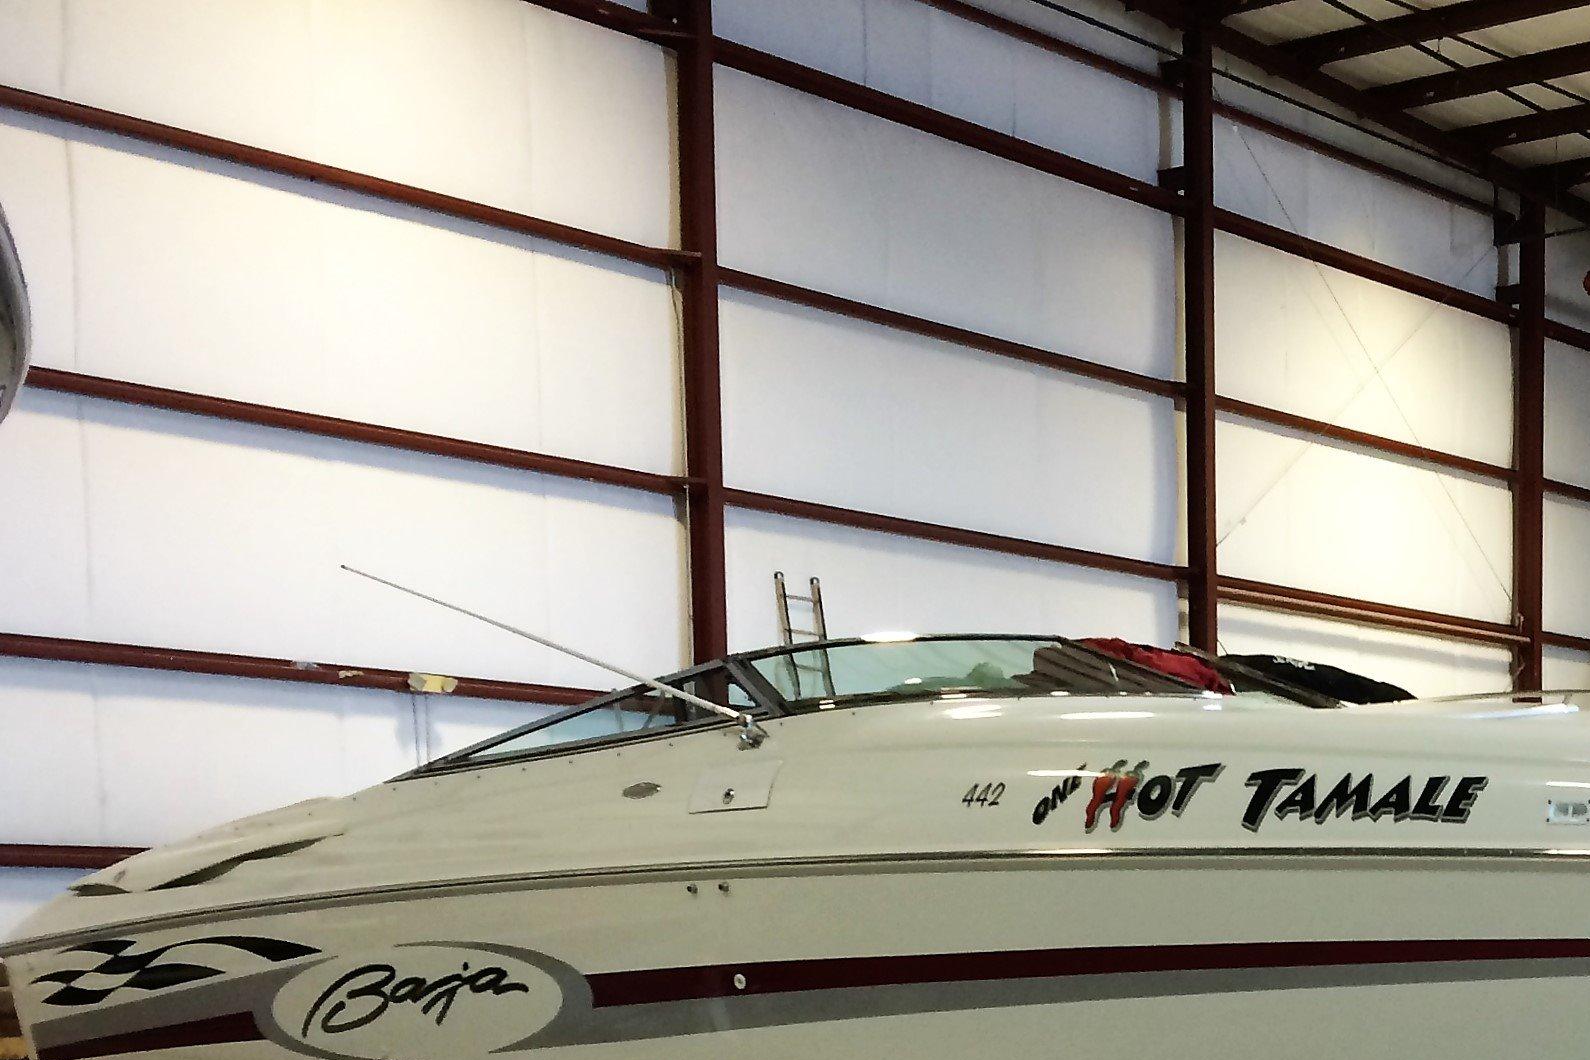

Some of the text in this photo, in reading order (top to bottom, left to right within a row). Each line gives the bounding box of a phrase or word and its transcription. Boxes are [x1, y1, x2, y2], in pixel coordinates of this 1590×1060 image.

[962, 781, 1006, 807] 442
[1241, 768, 1489, 833] TAMALE
[301, 961, 530, 1039] Baja
